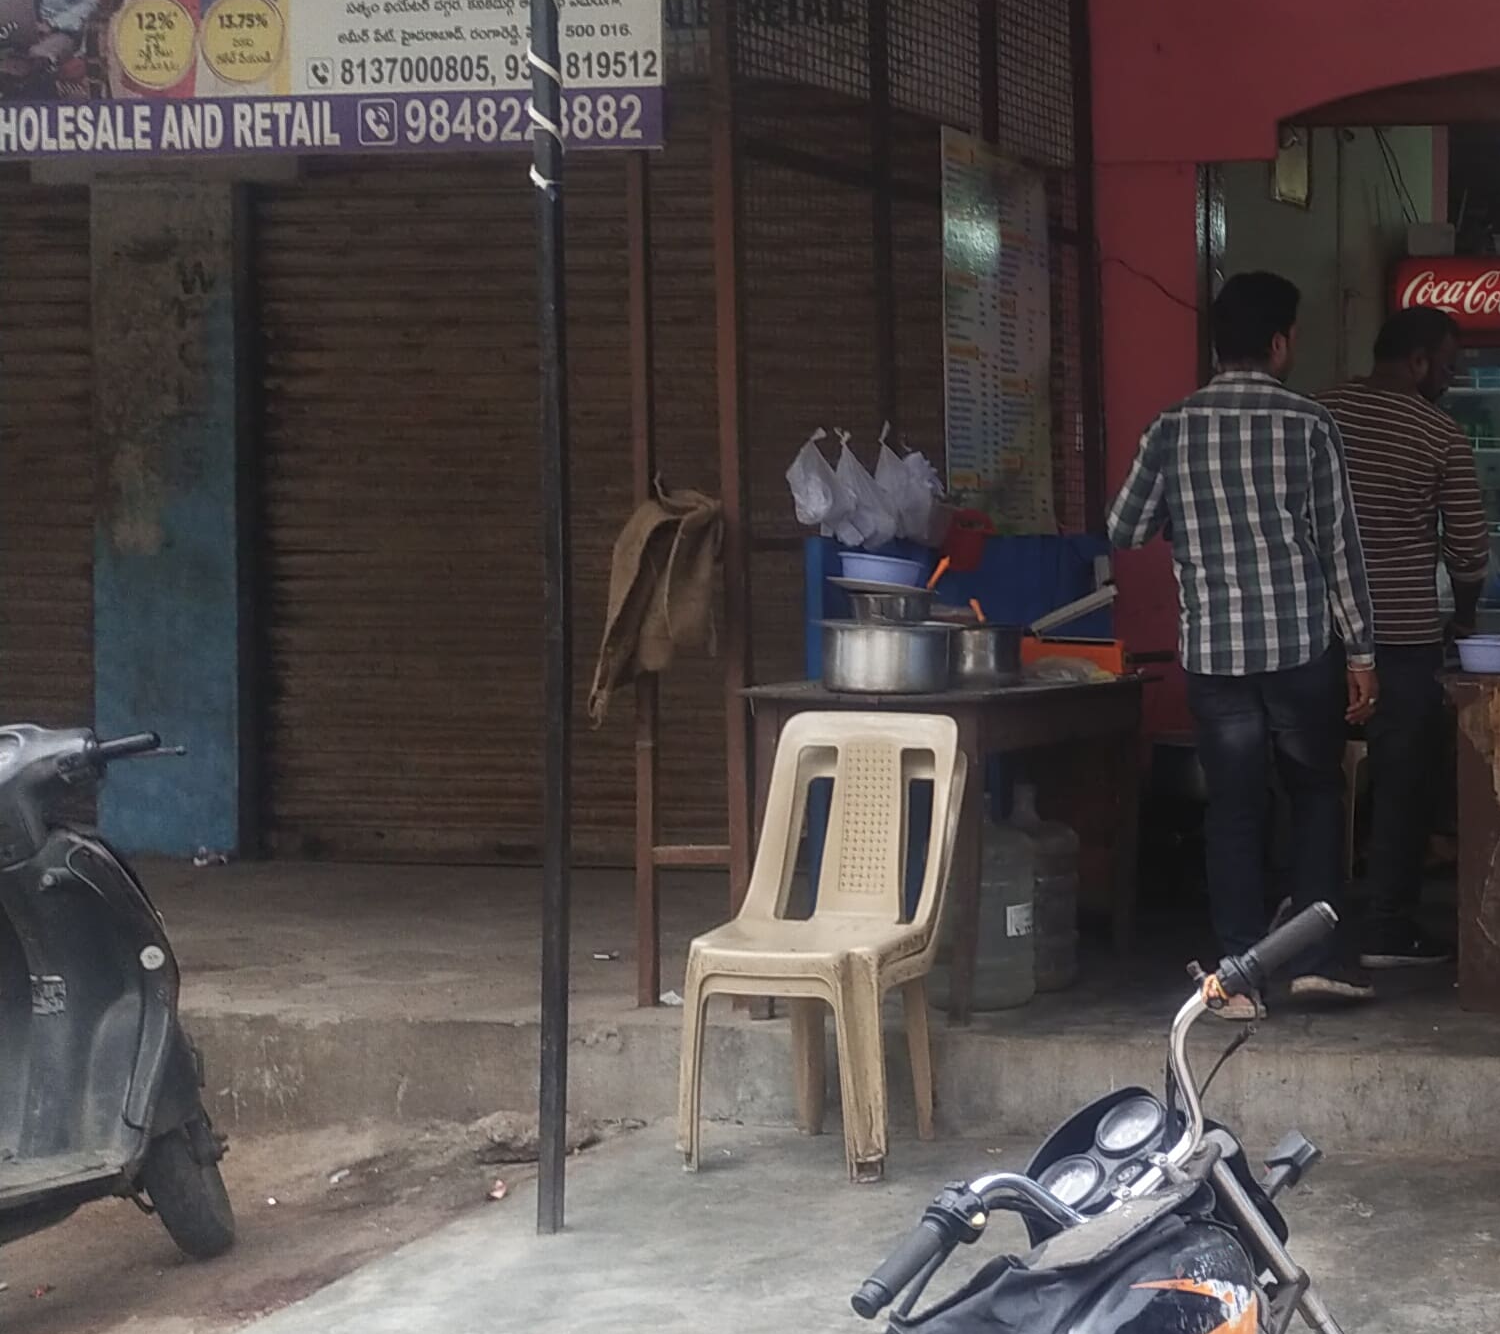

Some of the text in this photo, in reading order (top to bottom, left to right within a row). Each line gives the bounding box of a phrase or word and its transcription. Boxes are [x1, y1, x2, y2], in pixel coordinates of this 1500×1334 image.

[565, 24, 595, 38] 500
[505, 49, 658, 82] 93819512
[160, 102, 223, 150] AND
[233, 99, 341, 149] RETAIL
